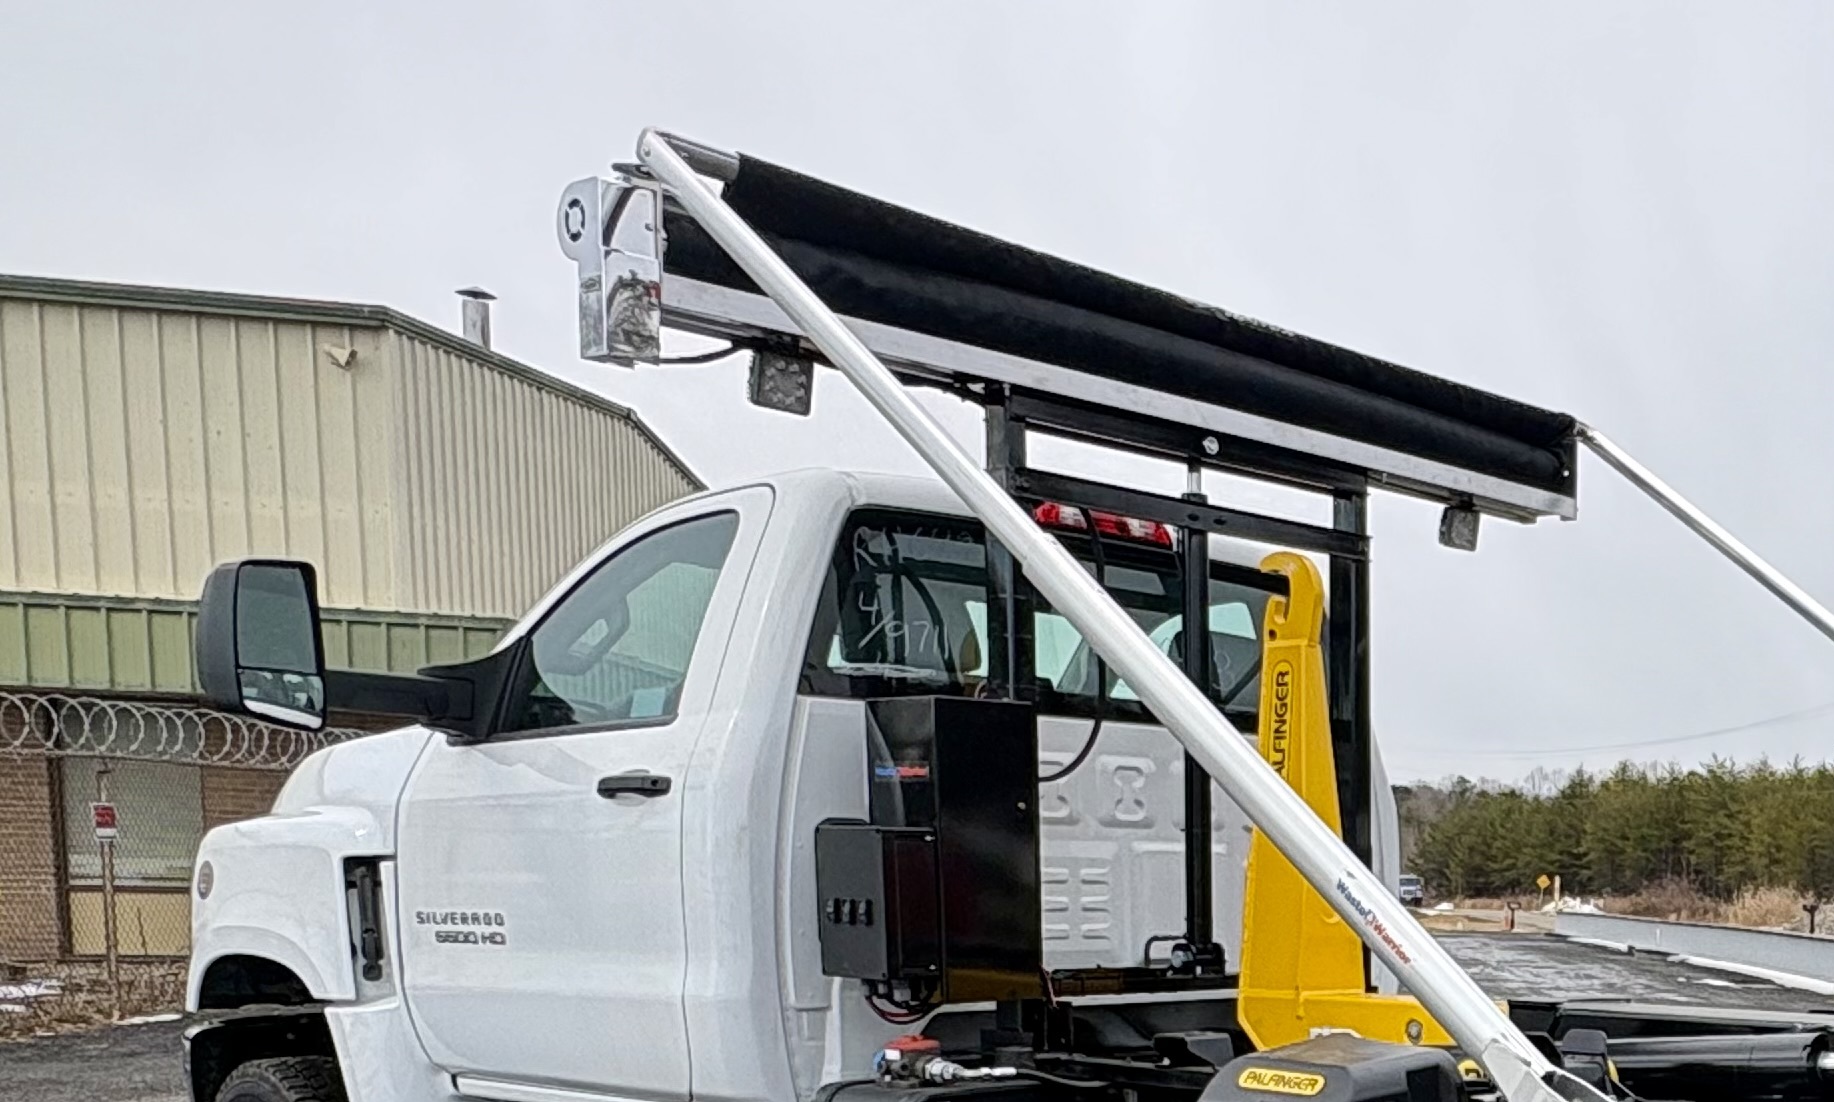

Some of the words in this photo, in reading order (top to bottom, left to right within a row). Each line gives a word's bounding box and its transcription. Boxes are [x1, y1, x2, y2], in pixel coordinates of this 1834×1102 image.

[1272, 670, 1290, 781] ALFINGER
[416, 910, 505, 927] SILVERADO
[1243, 1071, 1319, 1092] PALFINGER
